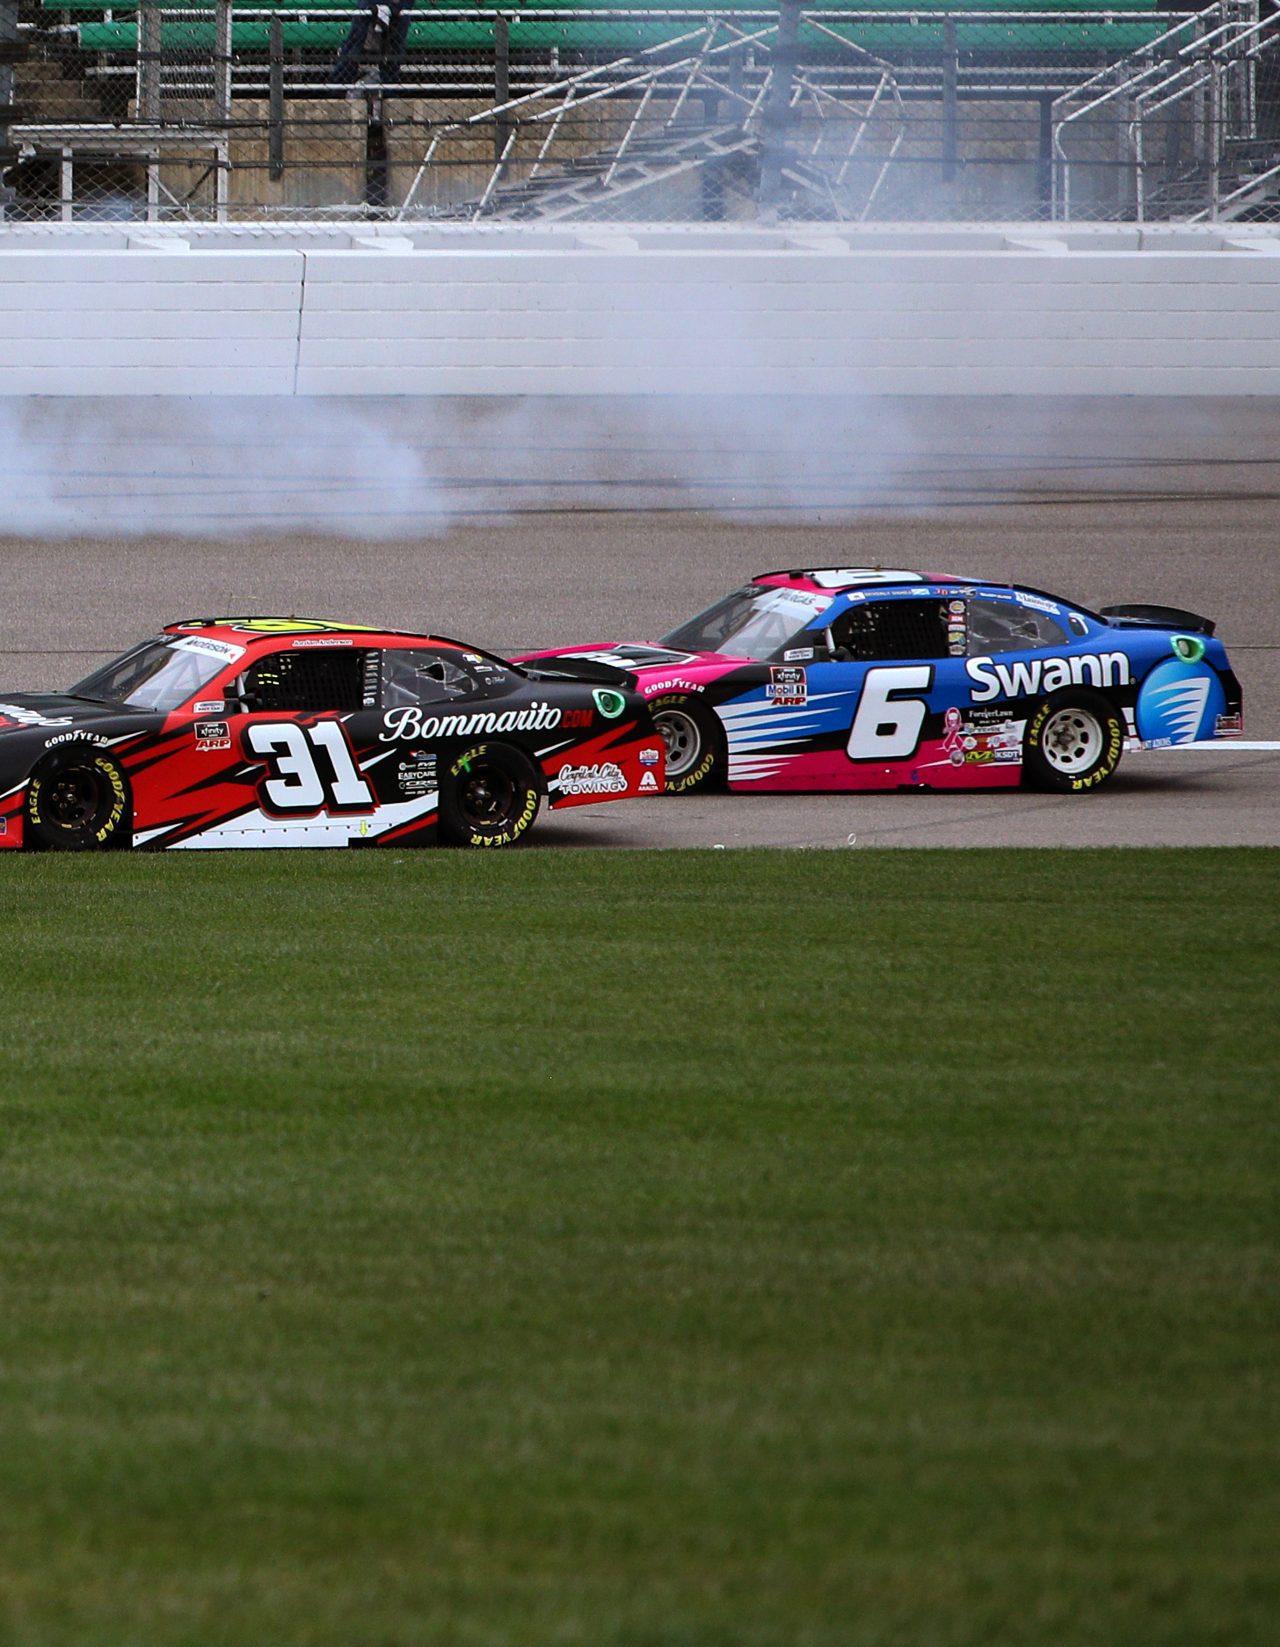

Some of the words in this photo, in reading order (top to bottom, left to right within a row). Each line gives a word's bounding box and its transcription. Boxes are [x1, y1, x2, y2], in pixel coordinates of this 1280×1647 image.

[644, 677, 705, 695] GOODYEAR
[768, 685, 794, 696] Mobil
[776, 672, 801, 683] xfinity
[965, 651, 1130, 702] Swann
[772, 697, 806, 706] ARP
[847, 664, 933, 761] 6
[45, 729, 109, 748] GOODYEAR
[197, 739, 230, 749] ARP
[200, 727, 224, 738] xfinity
[1029, 703, 1052, 747] EAGLE
[245, 719, 376, 812] 31
[664, 753, 715, 792] GOODY
[1071, 718, 1121, 790] GOODYEAR
[29, 779, 42, 824] EAGLE
[94, 757, 126, 842] GOODYEAR
[560, 781, 622, 793] TOWING
[470, 789, 537, 847] GOODYEAR
